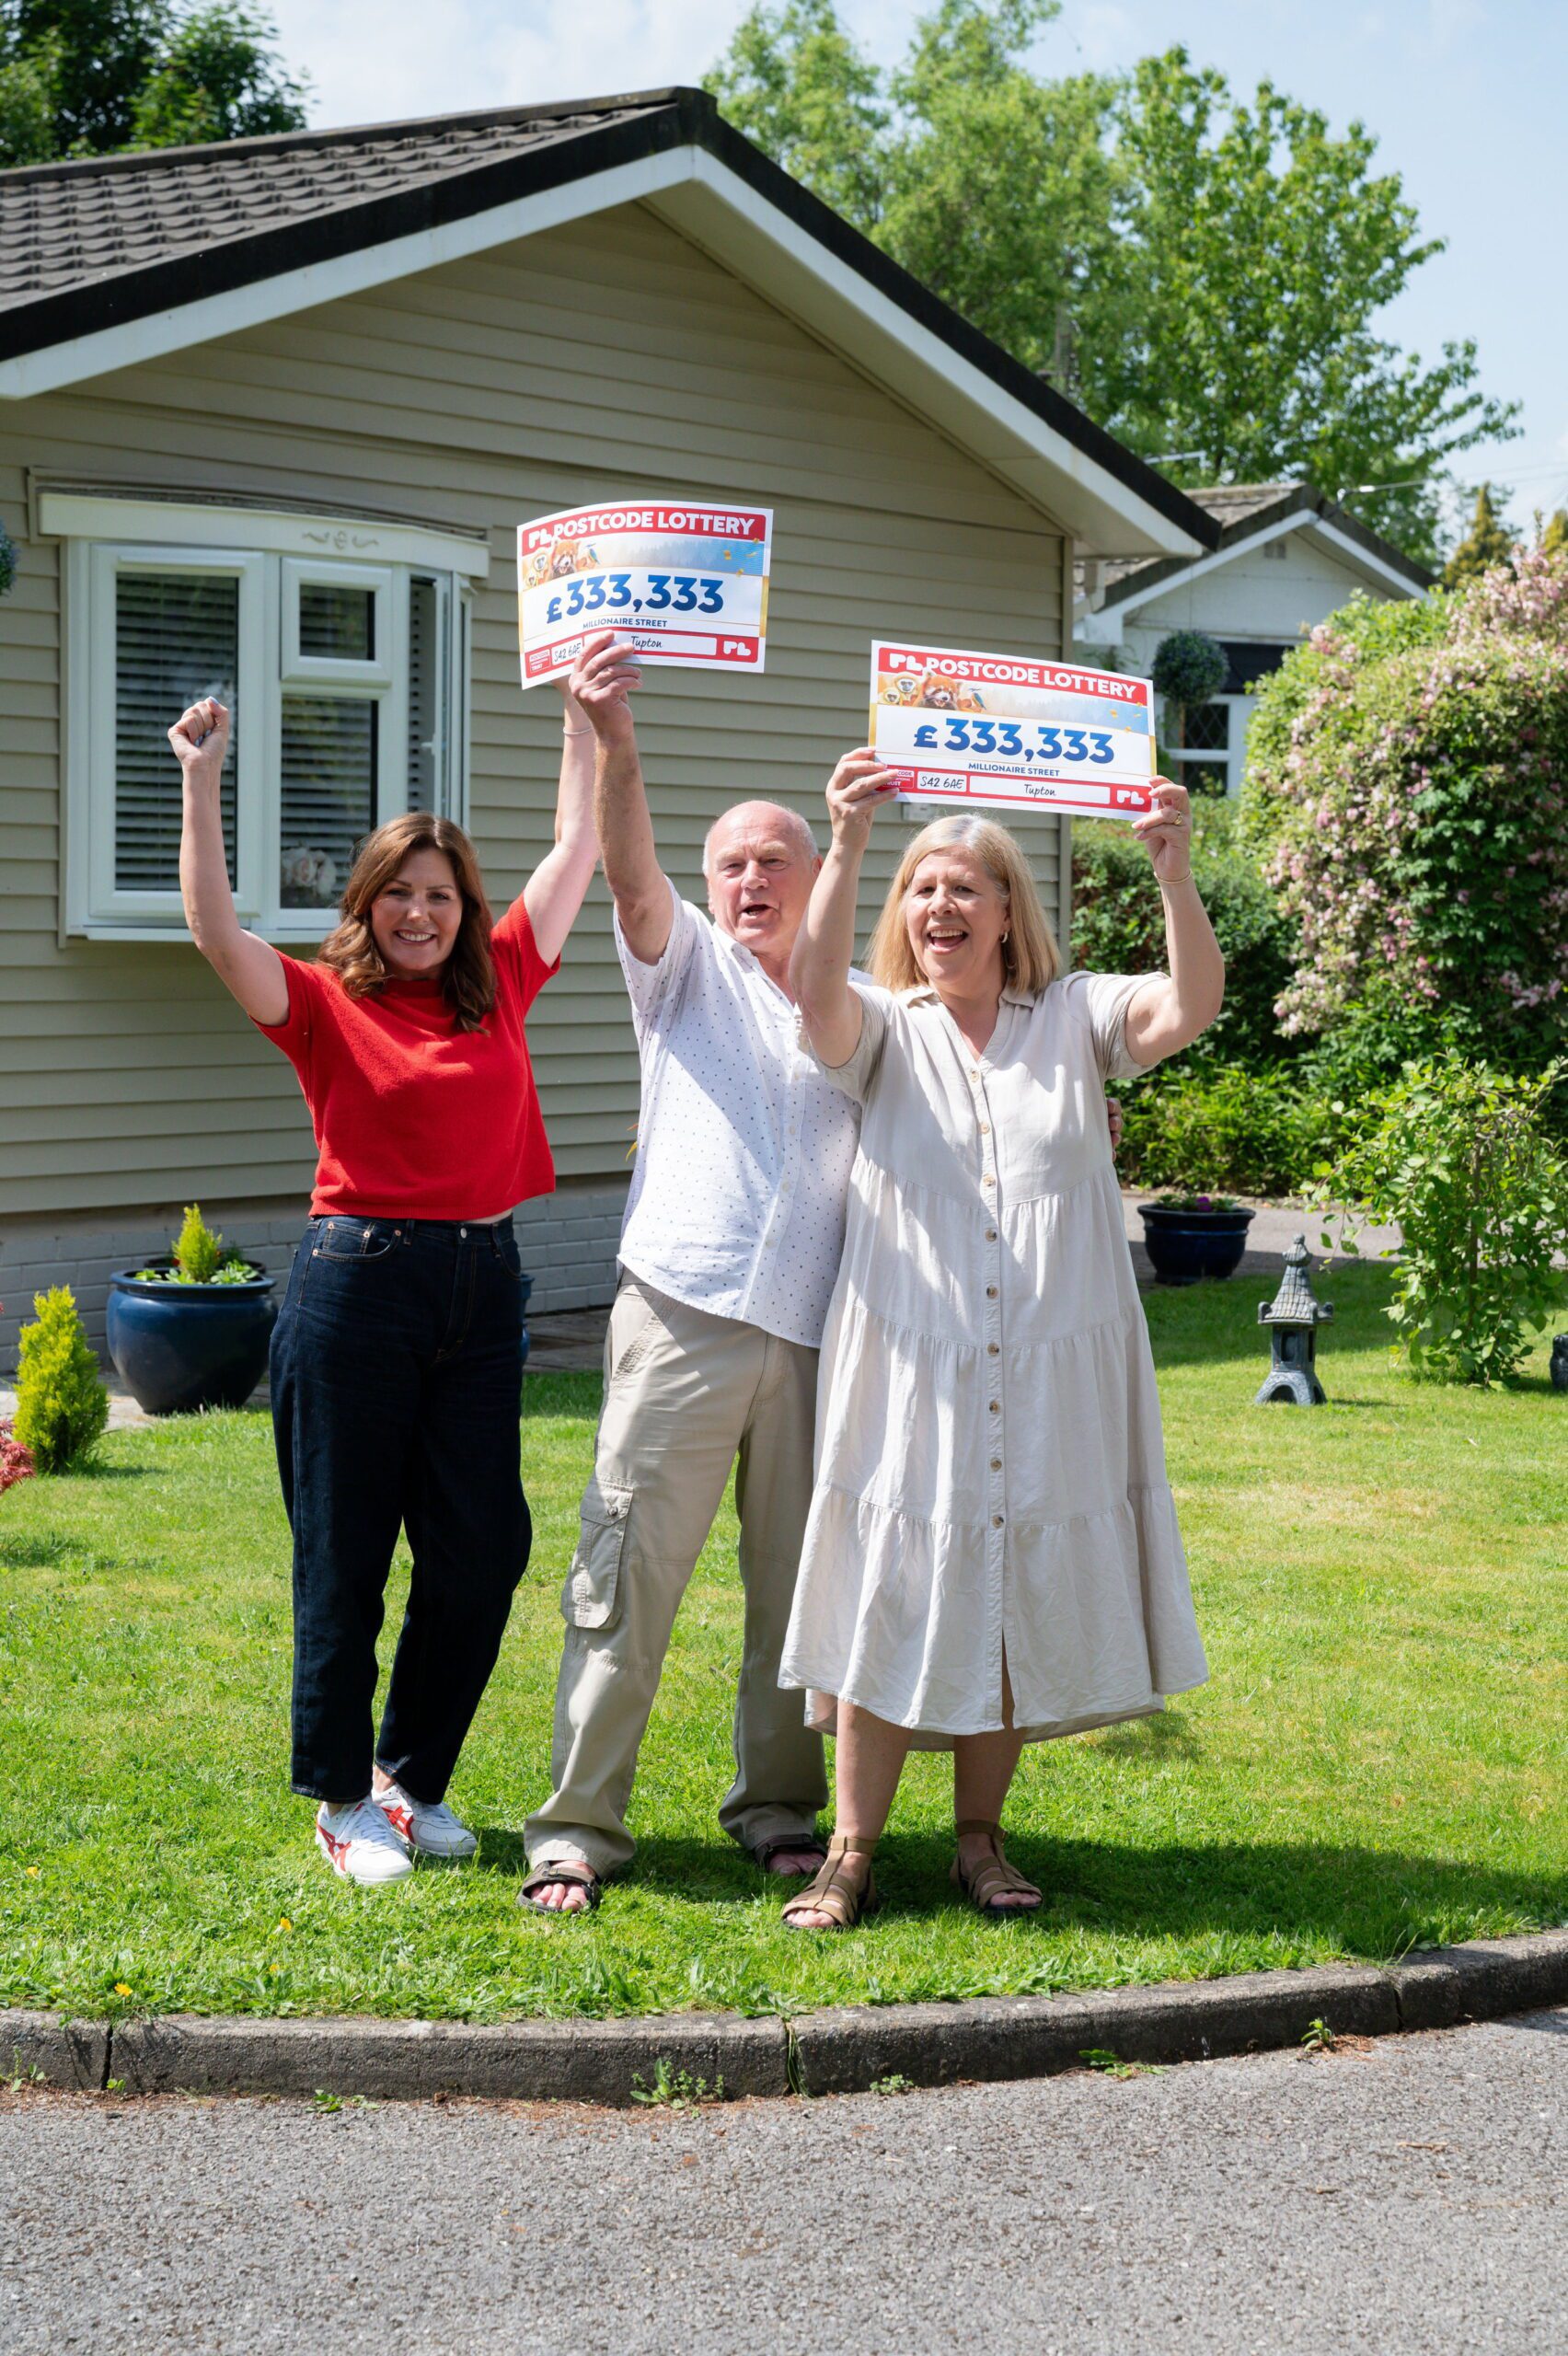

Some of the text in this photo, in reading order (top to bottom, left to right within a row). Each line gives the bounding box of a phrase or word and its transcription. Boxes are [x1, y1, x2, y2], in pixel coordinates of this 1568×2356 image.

[553, 511, 652, 537] POSTCODE
[658, 512, 755, 535] LOTTERY
[547, 573, 723, 624] £333,333
[582, 618, 668, 629] MILLIONAIRE STREET
[631, 635, 663, 650] Tupton
[554, 648, 567, 662] S42
[924, 656, 1039, 684] POSTCODE
[1043, 670, 1137, 699] LOTTERY
[914, 718, 1114, 763] £333,333
[968, 763, 1060, 777] MILLIONAIRE STREET
[920, 776, 940, 787] S42
[943, 778, 964, 789] 6AE
[1023, 783, 1056, 797] Tupton
